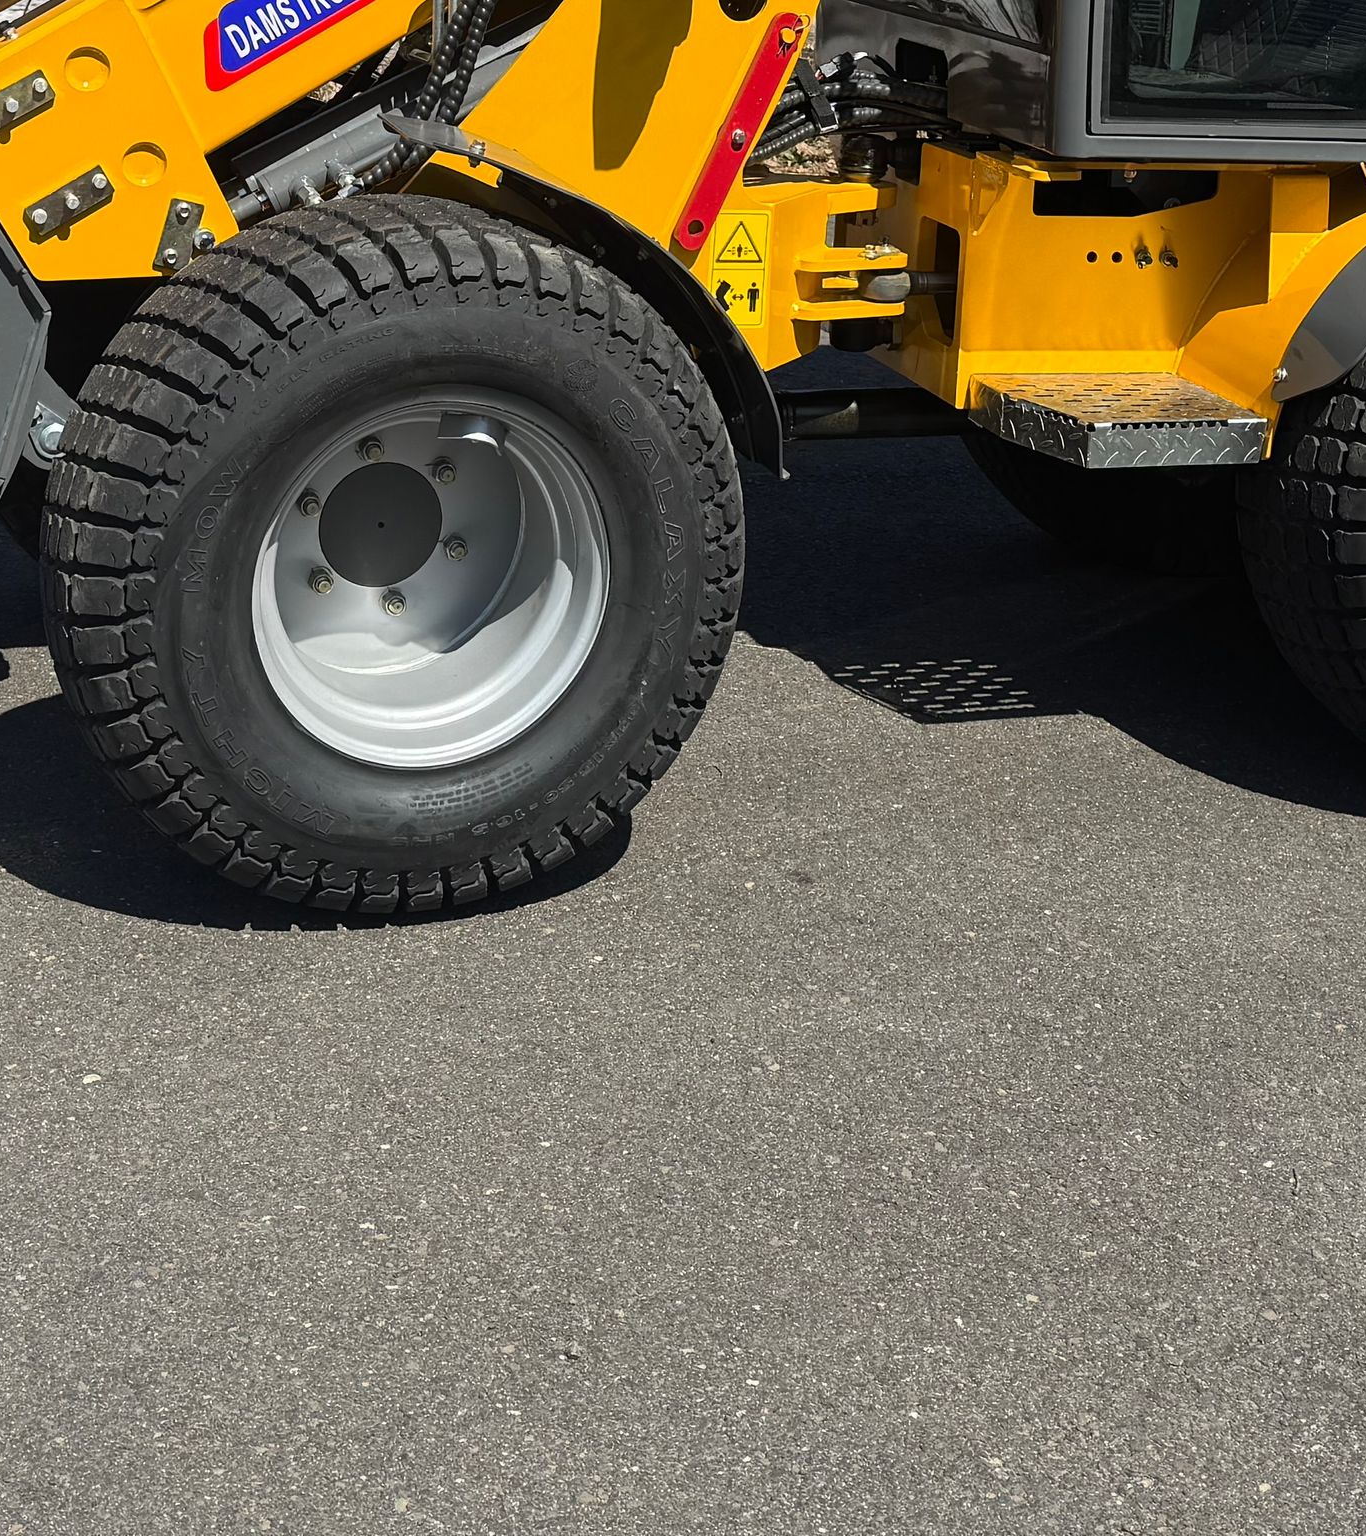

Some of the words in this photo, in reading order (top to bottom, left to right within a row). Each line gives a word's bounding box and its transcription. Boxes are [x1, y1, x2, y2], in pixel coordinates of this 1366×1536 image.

[276, 360, 314, 393] PLY
[319, 327, 397, 362] RATING
[181, 456, 247, 595] MOW
[609, 396, 687, 671] GALAXY
[181, 645, 346, 838] MIGHTY
